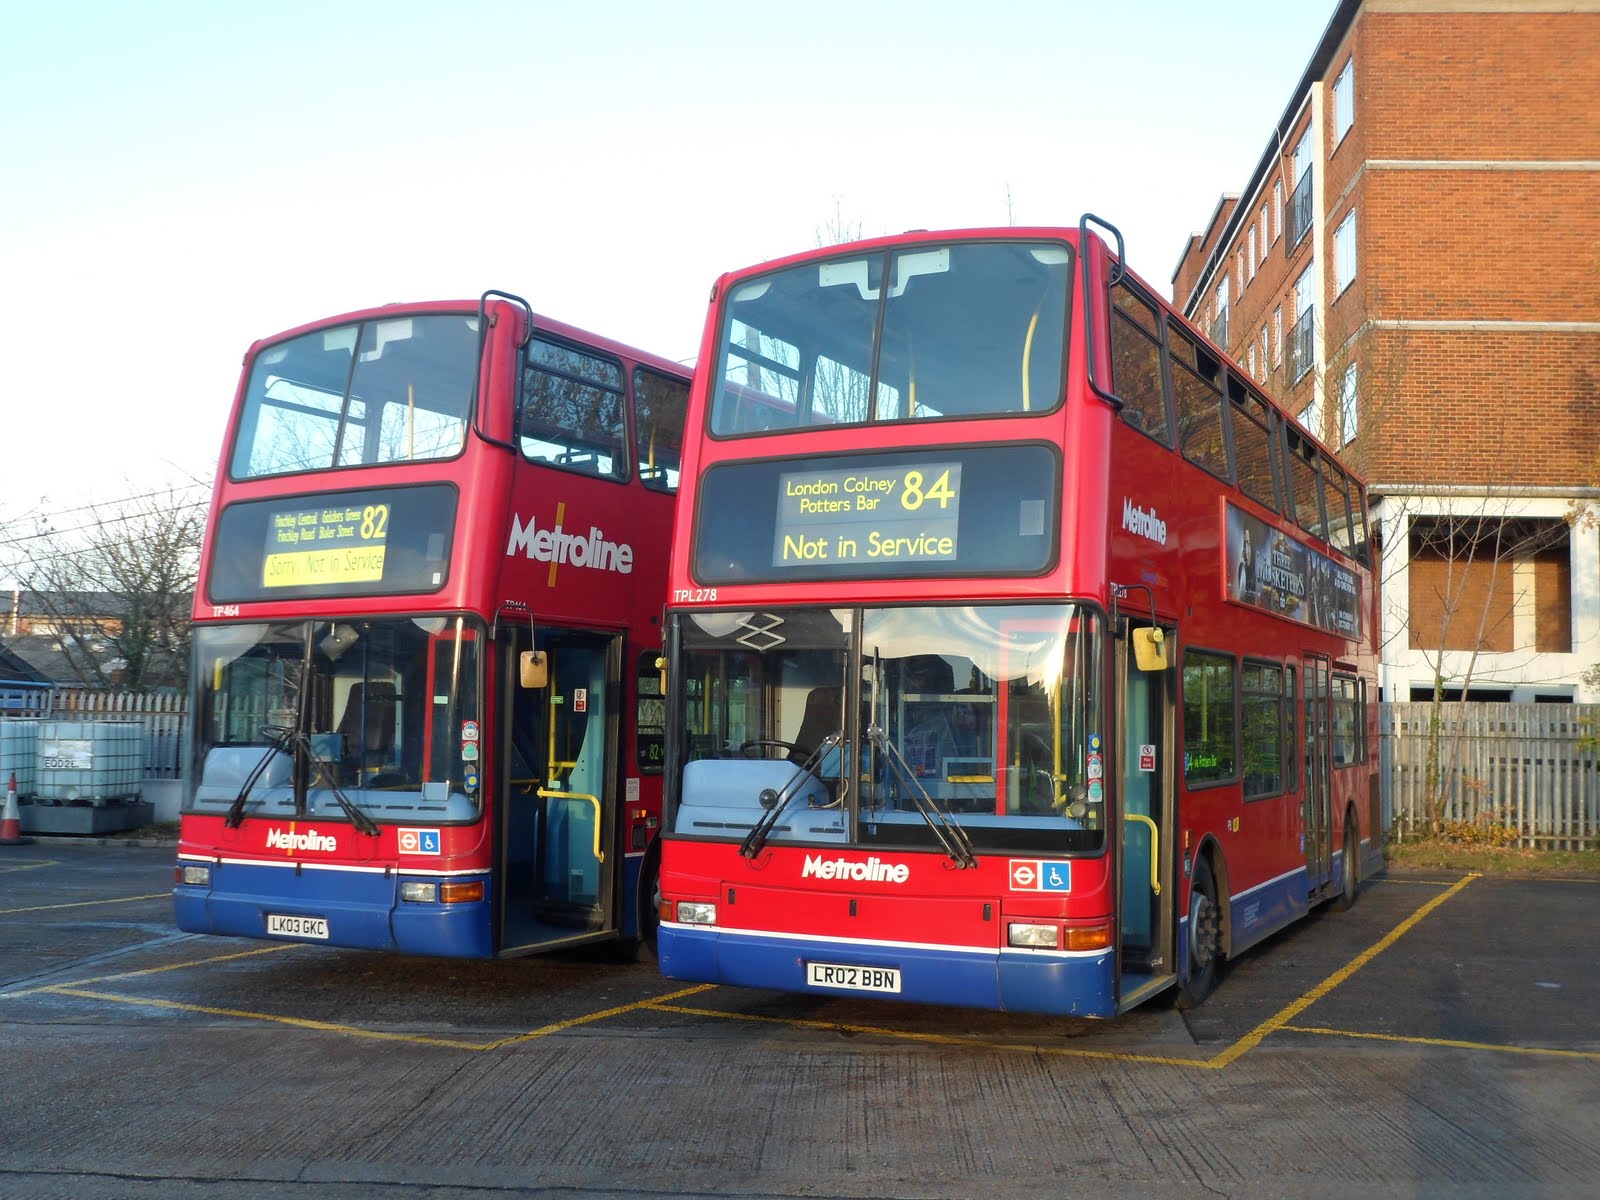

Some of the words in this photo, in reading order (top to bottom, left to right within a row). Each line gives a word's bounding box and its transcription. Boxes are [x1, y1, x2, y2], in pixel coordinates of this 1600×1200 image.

[787, 480, 838, 496] London
[844, 476, 896, 495] Colney
[901, 469, 955, 511] 84
[800, 498, 850, 514] Potters
[857, 495, 880, 511] Bar
[360, 504, 388, 540] 82
[1122, 495, 1167, 545] Metroline
[506, 512, 633, 574] Metroline
[783, 535, 828, 560] Not
[838, 536, 856, 558] in
[867, 531, 953, 557] Service
[344, 550, 383, 570] Service
[674, 588, 717, 602] TPL278
[212, 604, 240, 617] TP464
[266, 828, 337, 852] Metroline
[802, 854, 910, 884] Metroline
[272, 917, 300, 933] LK03
[303, 920, 324, 935] GKC
[814, 966, 857, 985] LR02
[862, 970, 895, 989] BBN
